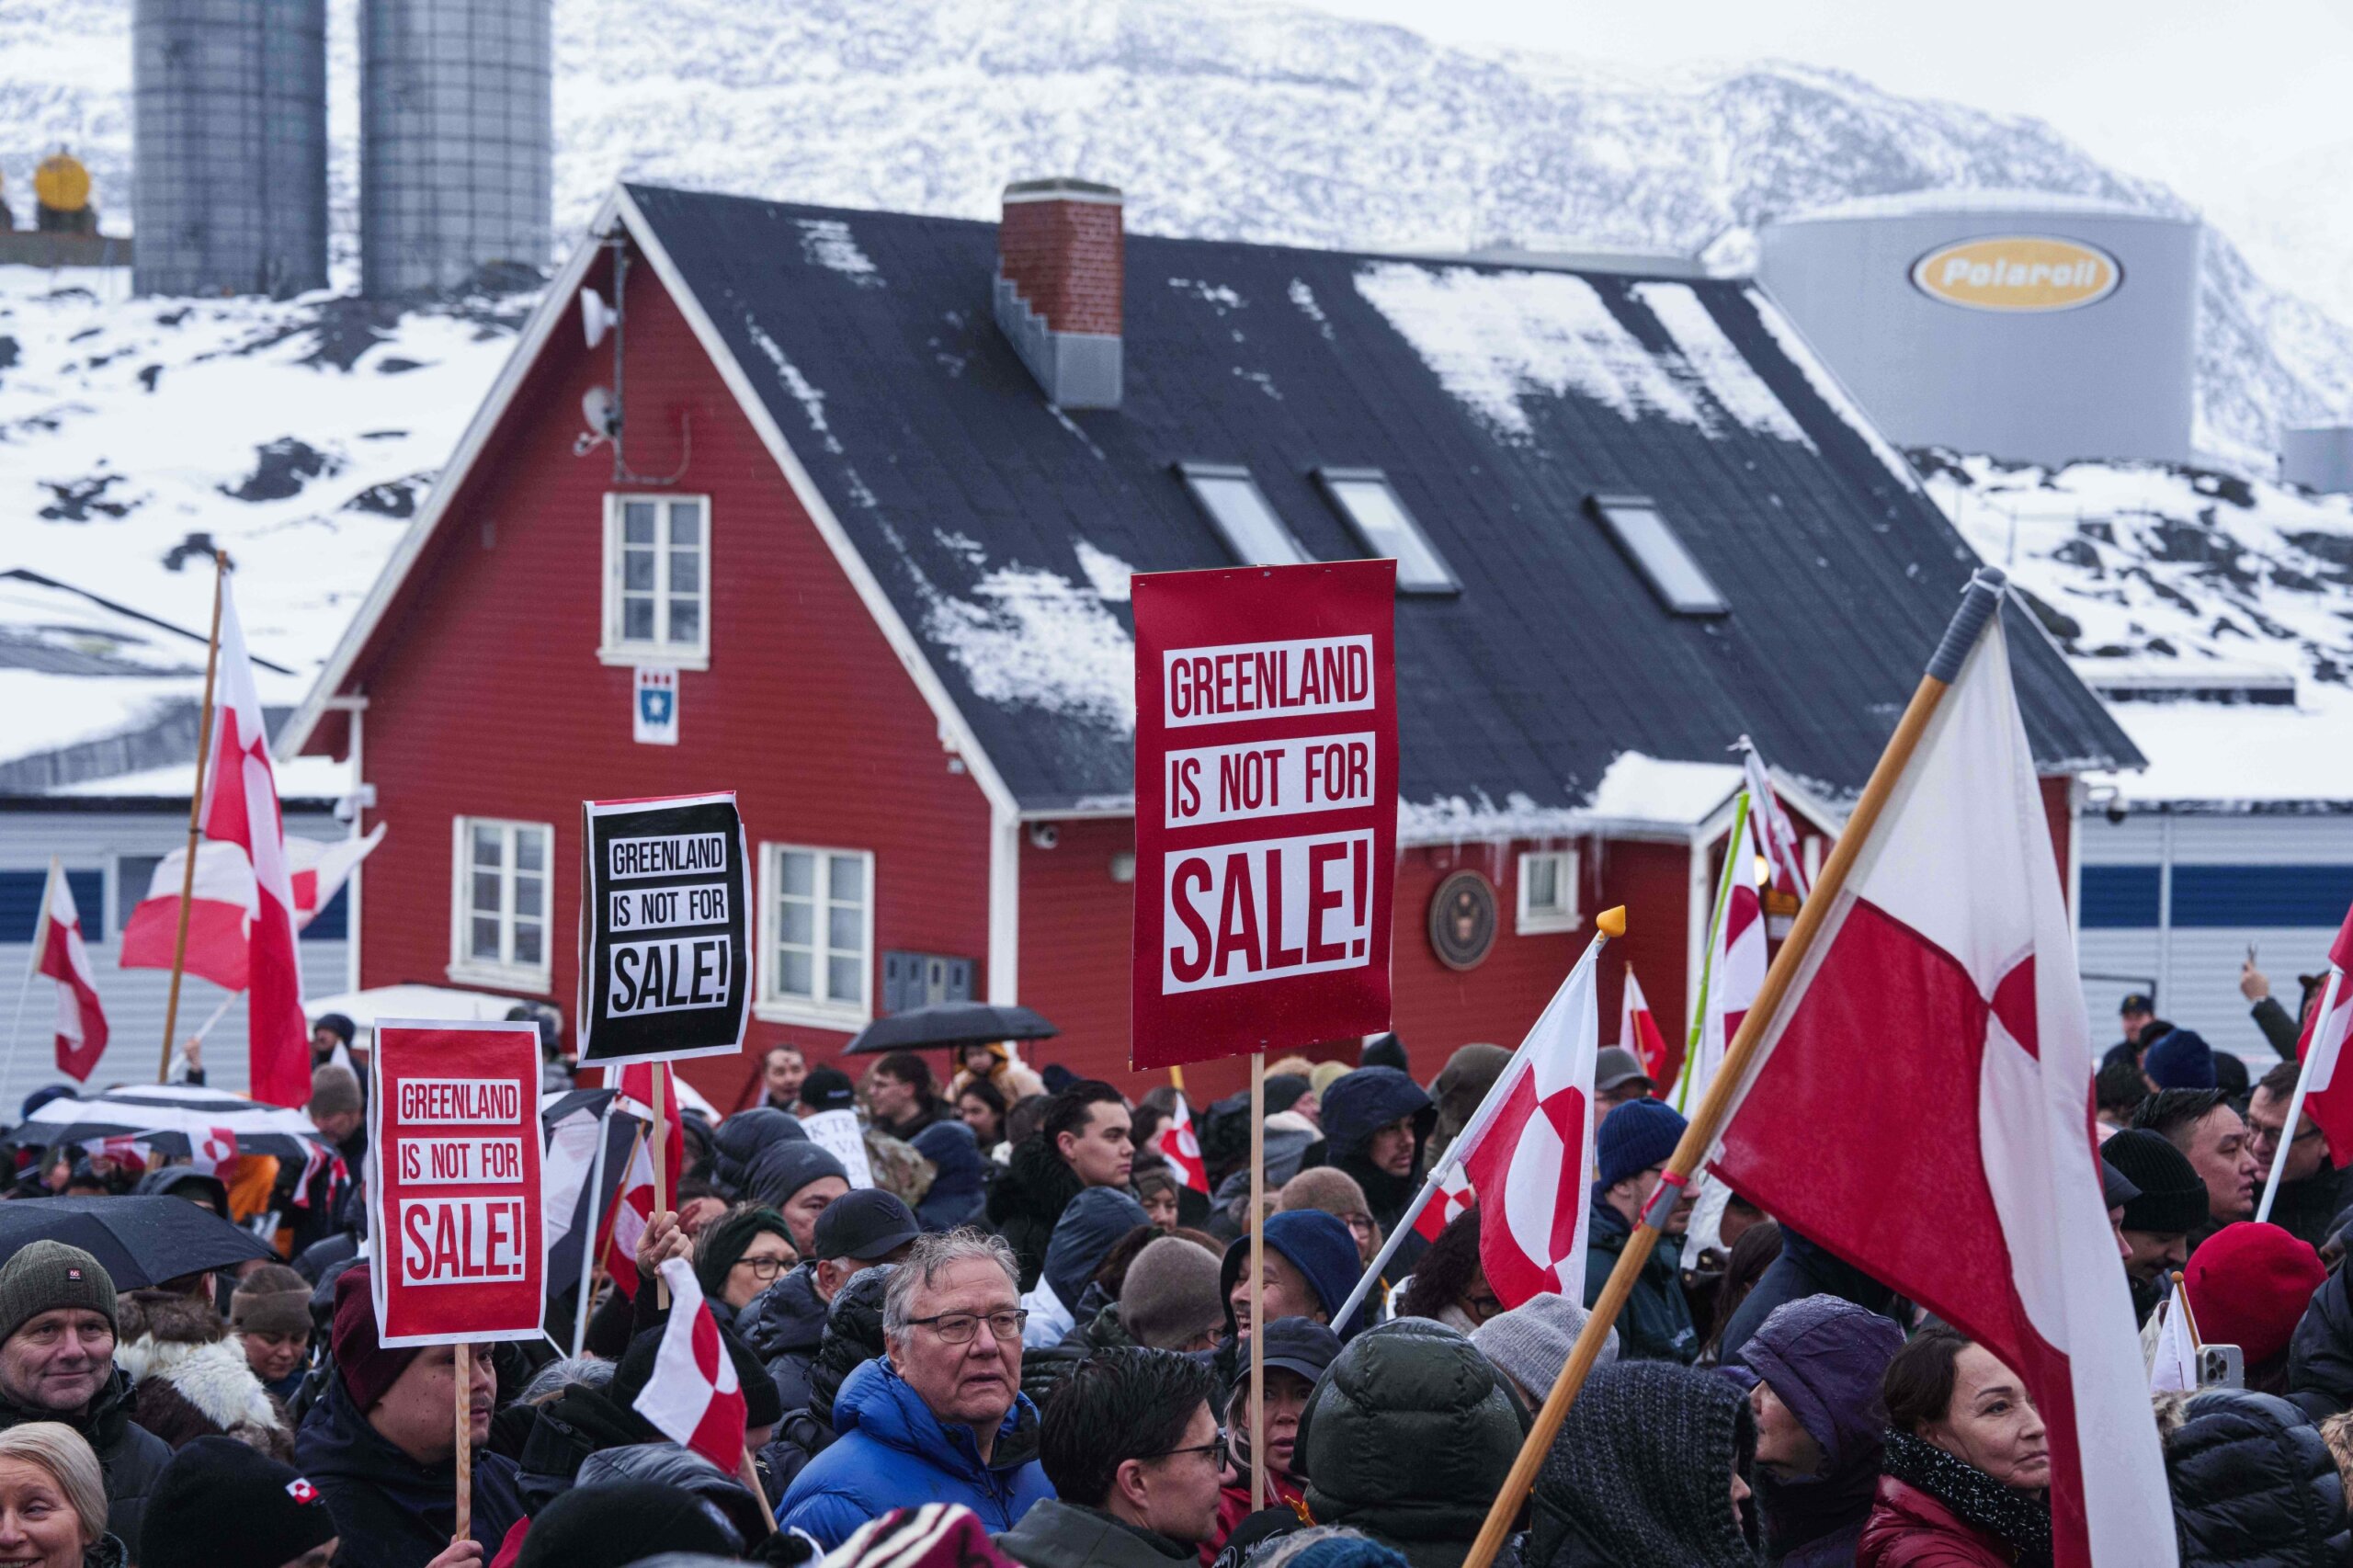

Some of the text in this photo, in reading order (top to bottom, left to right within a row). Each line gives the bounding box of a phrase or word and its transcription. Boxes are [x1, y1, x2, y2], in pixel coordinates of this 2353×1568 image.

[1942, 256, 2097, 288] Polaroil
[1170, 644, 1369, 718] GREENLAND
[1171, 741, 1369, 818] IS NOT FOR
[612, 837, 723, 875] GREENLAND
[613, 889, 724, 926] IS NOT FOR
[1170, 839, 1368, 983] SALE!
[612, 940, 727, 1013] SALE!
[402, 1083, 517, 1119] GREENLAND
[402, 1142, 519, 1180] IS NOT FOR
[404, 1202, 522, 1280] SALE!
